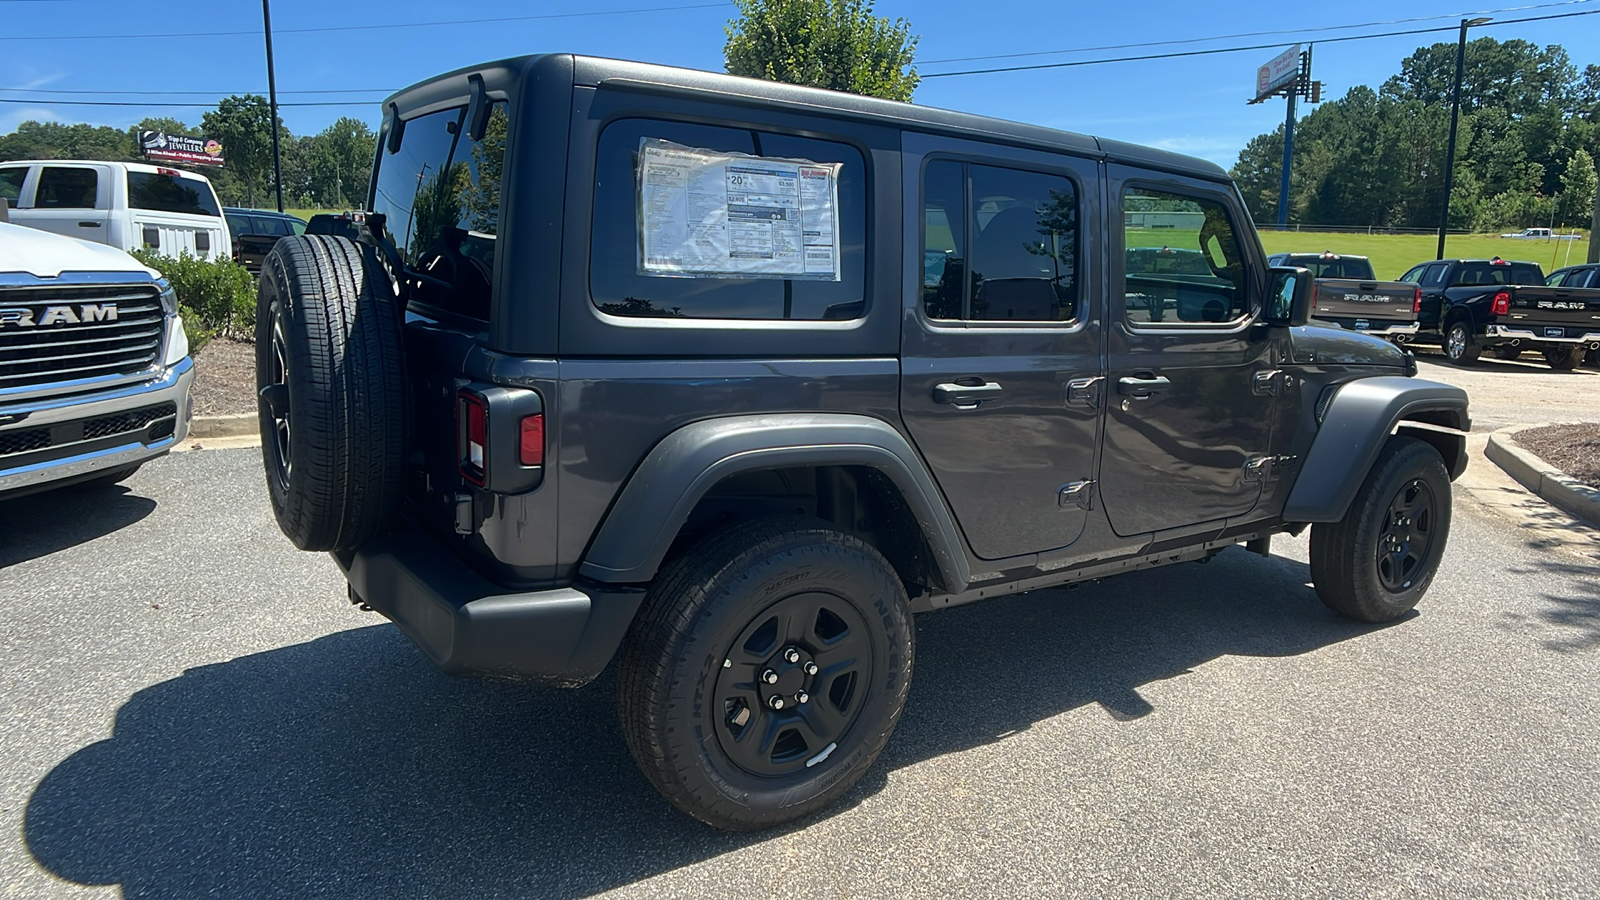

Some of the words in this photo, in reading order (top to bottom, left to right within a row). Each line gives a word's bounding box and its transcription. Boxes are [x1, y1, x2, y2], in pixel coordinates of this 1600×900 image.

[169, 142, 204, 153] JEWELERS
[731, 175, 743, 185] 20
[1344, 293, 1390, 302] RAM
[1537, 300, 1585, 310] RAM
[0, 303, 118, 328] RAM
[874, 598, 897, 690] NEXEN
